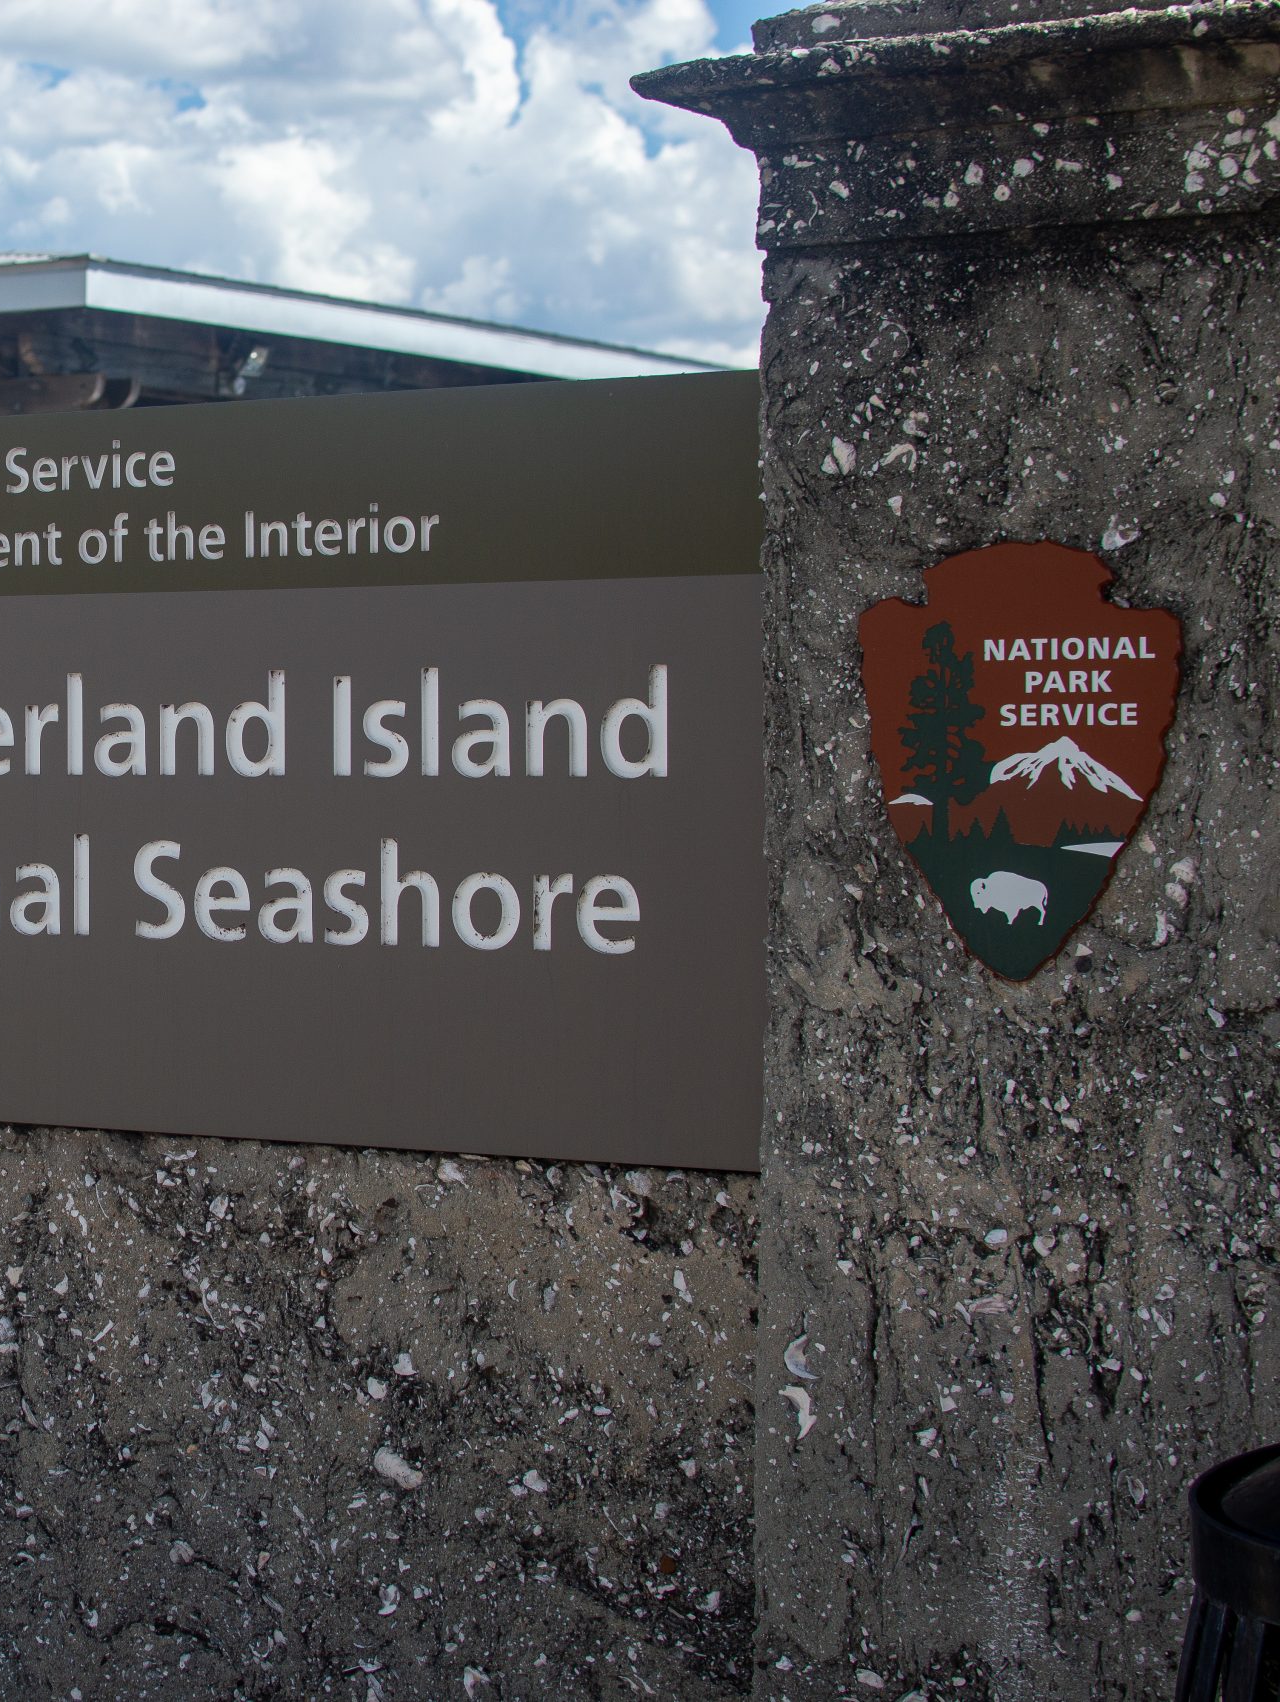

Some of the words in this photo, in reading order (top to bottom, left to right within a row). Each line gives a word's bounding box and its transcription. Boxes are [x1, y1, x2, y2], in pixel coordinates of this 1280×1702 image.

[5, 439, 176, 494] Service
[78, 512, 129, 565] of
[143, 510, 226, 562] the
[245, 503, 440, 558] Interior
[983, 636, 1156, 662] NATIONAL
[1025, 670, 1113, 694] PARK
[333, 664, 668, 779] Island
[999, 702, 1138, 727] SERVICE
[133, 838, 641, 955] Seashore
